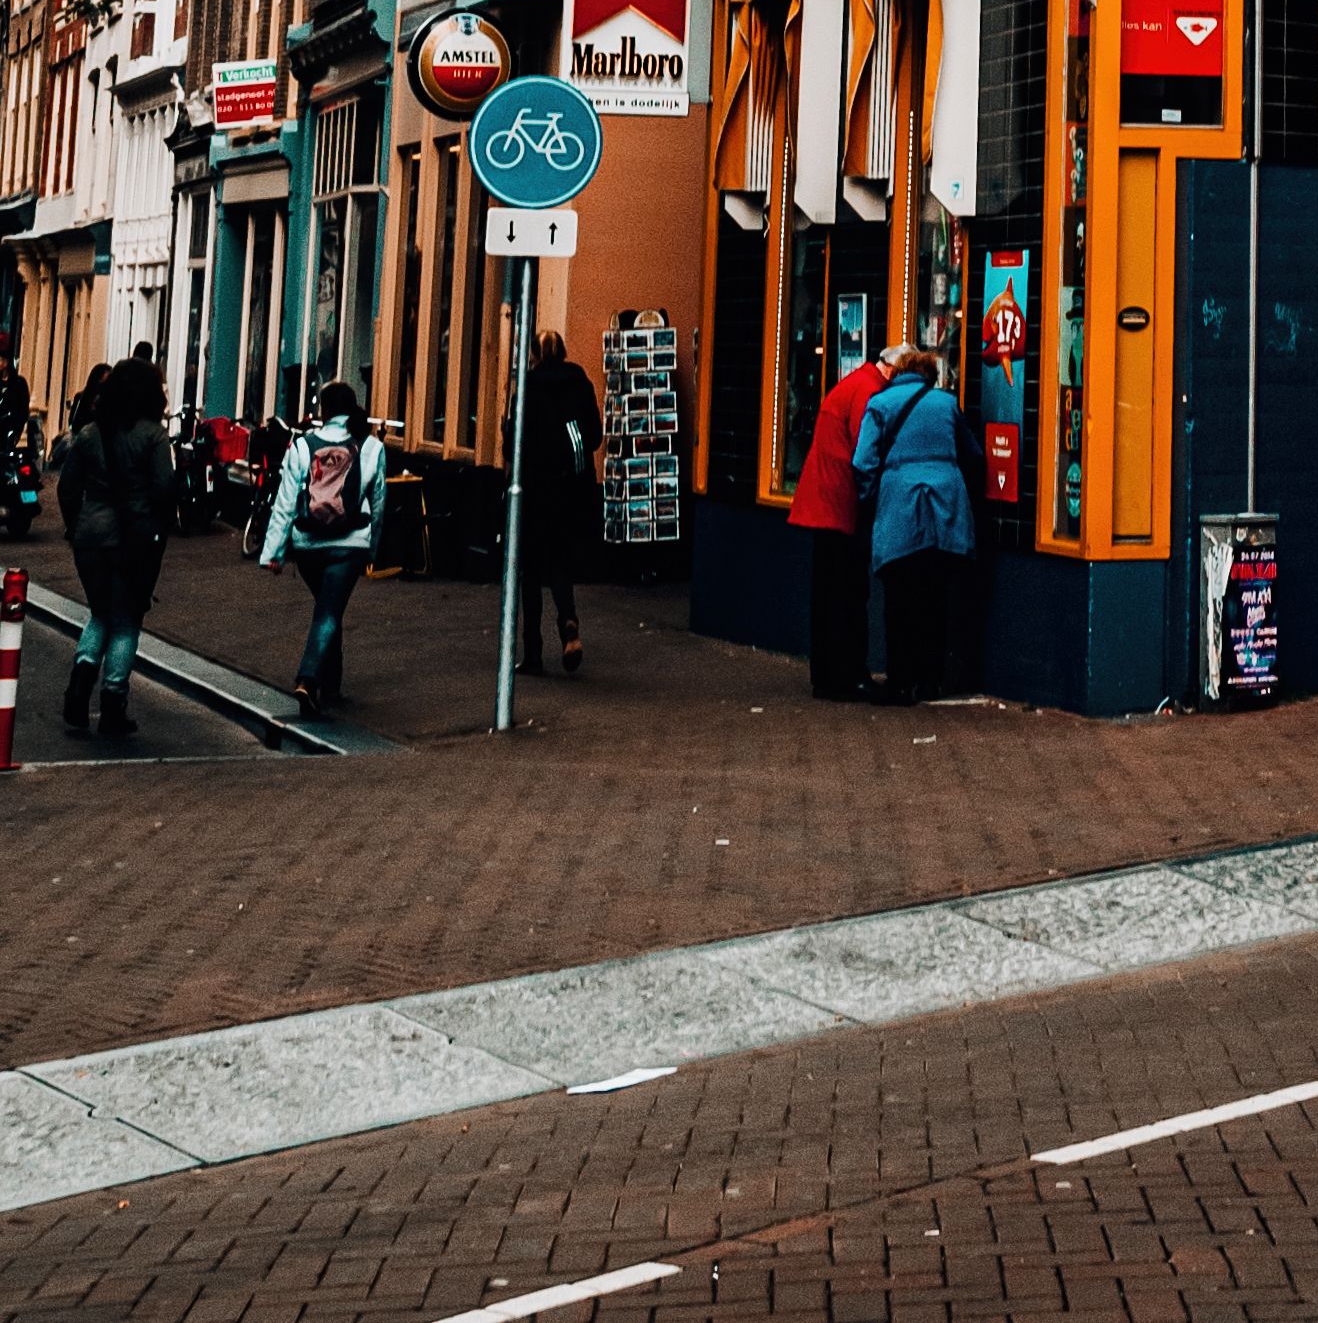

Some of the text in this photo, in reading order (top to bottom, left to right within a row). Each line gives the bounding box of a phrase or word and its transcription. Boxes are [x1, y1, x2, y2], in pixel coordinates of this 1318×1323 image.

[1142, 21, 1163, 32] kan
[440, 50, 496, 64] AMSTEL
[570, 36, 684, 80] Marlboro
[225, 66, 273, 82] Verkocht
[631, 98, 680, 110] dodelijk
